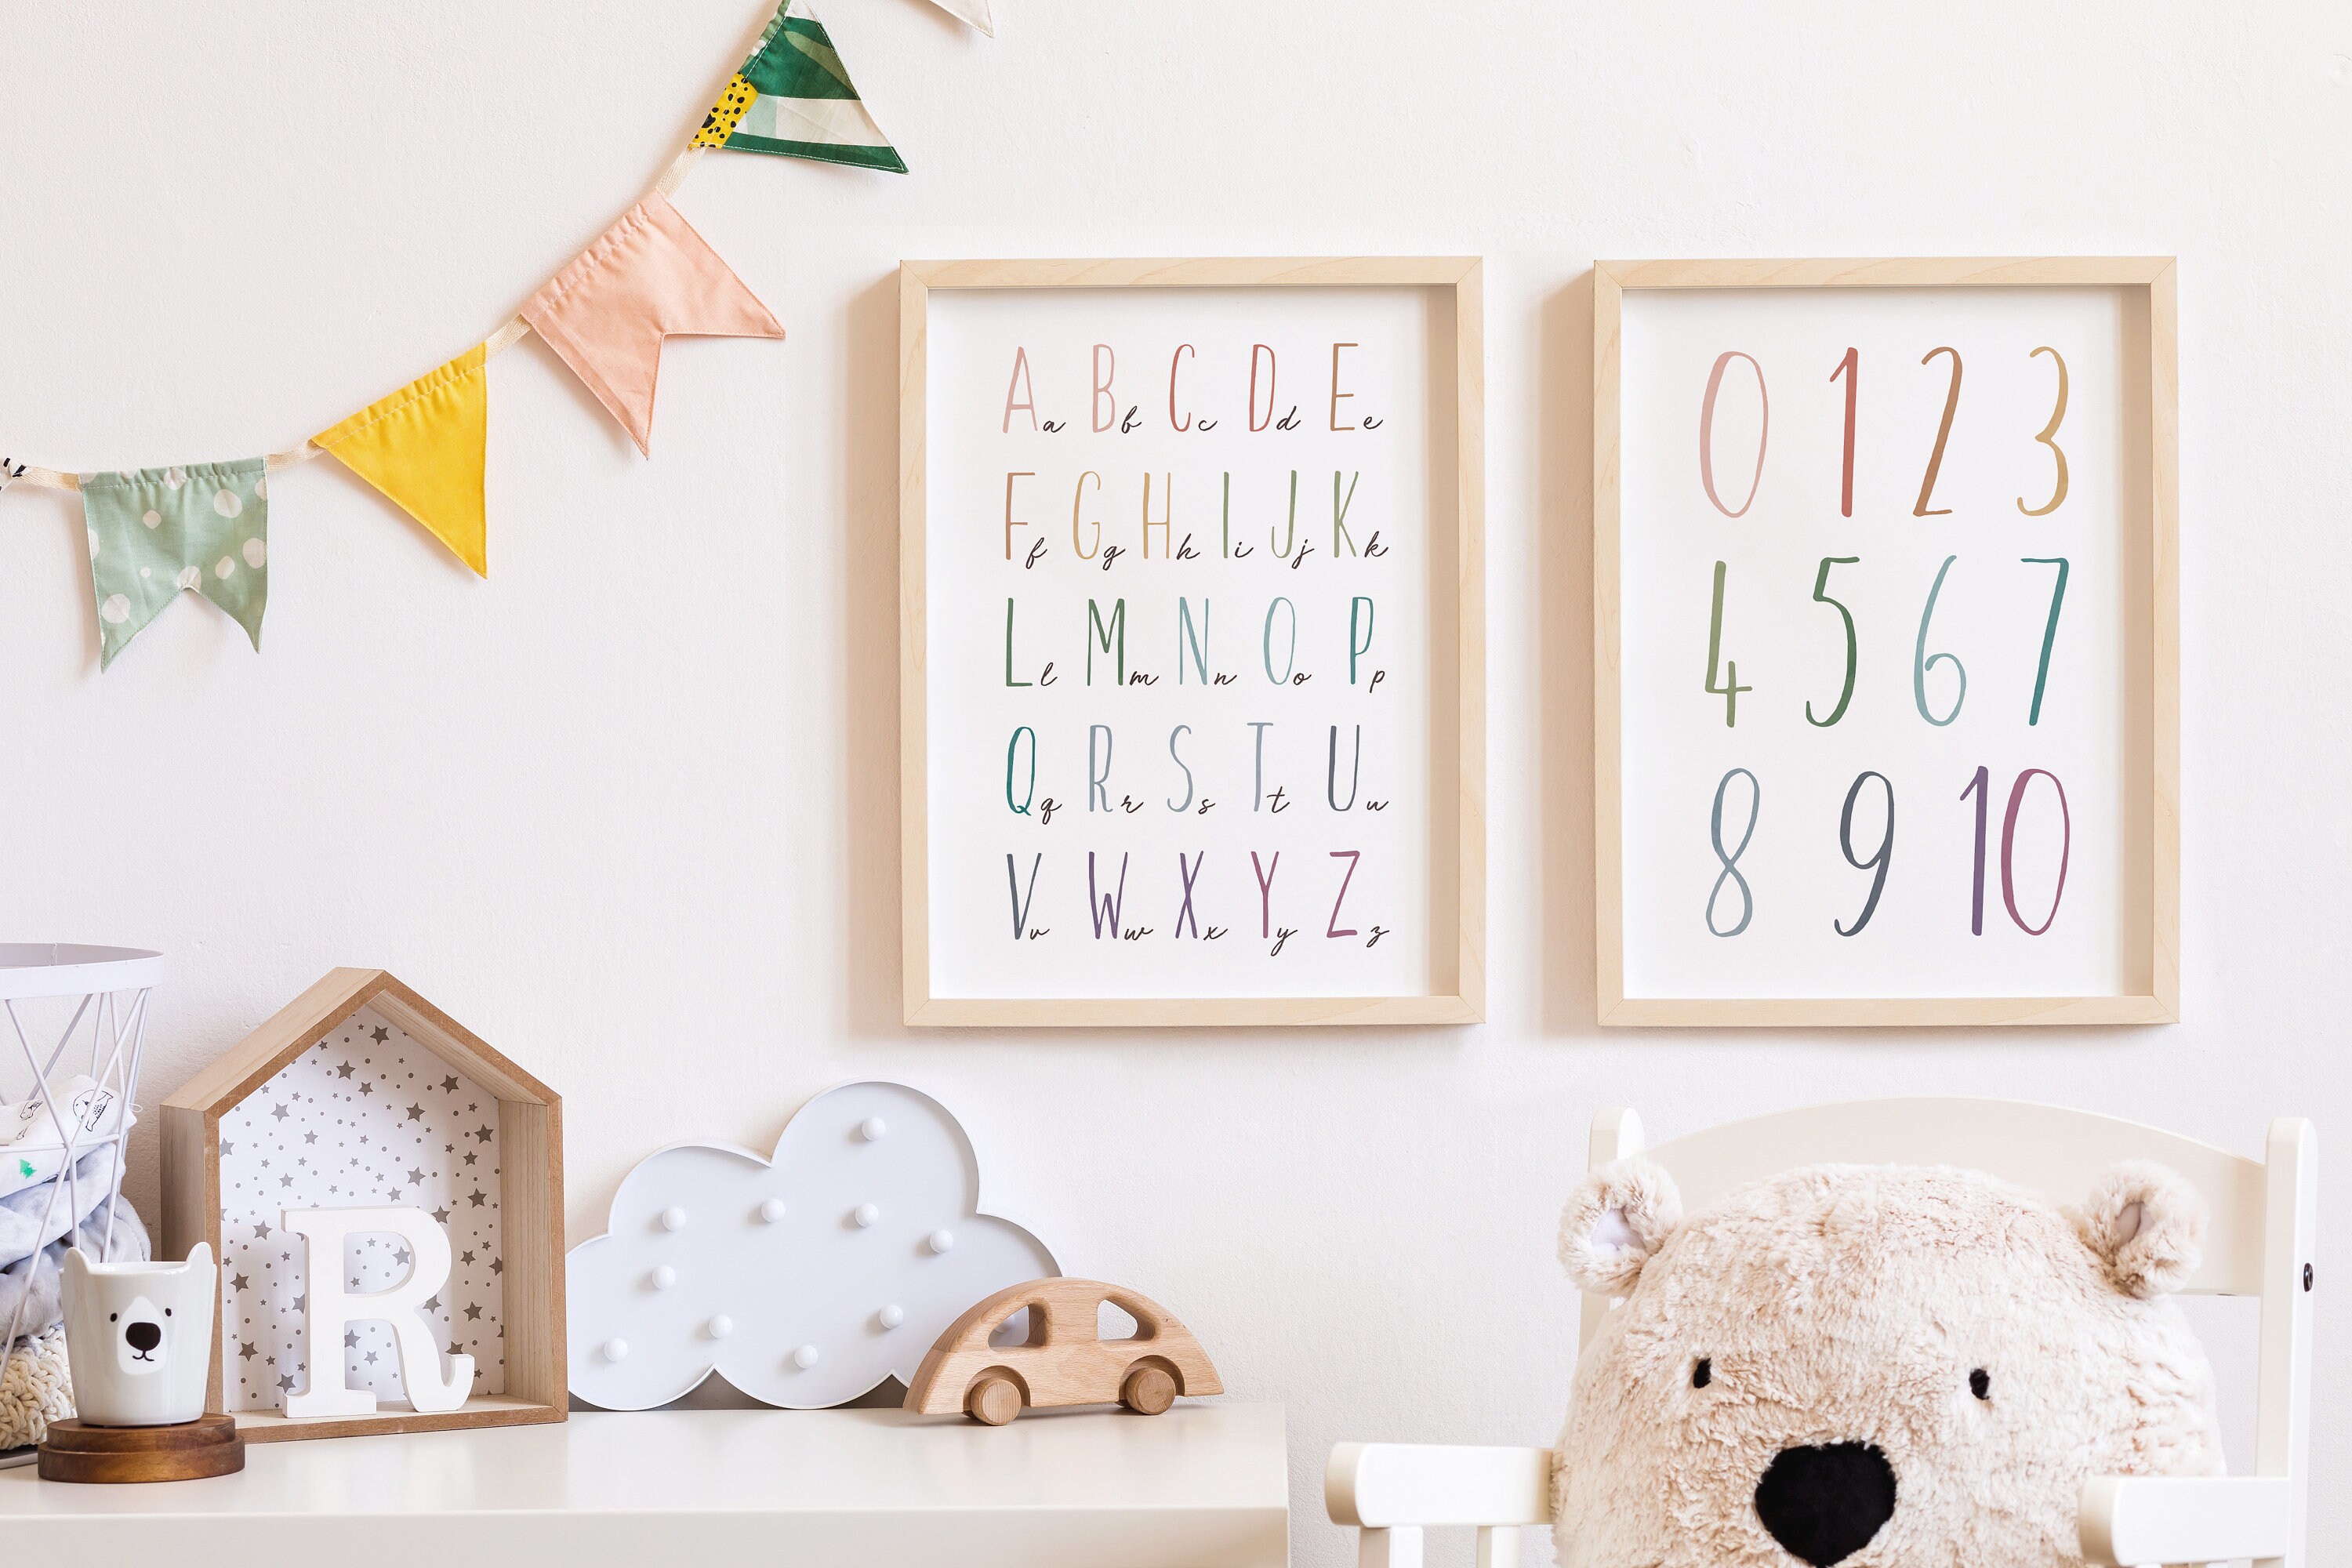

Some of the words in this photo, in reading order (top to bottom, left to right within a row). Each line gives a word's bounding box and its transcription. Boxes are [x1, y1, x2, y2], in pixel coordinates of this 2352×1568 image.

[1699, 350, 1769, 519] 0
[1829, 347, 1859, 518] 1
[1912, 346, 1963, 518] 2
[2016, 346, 2069, 517] 3
[1704, 560, 1753, 728] 4
[1805, 556, 1860, 728] 5
[1913, 554, 1967, 728] 6
[2020, 557, 2070, 727] 7
[1705, 768, 1761, 938] 8
[1834, 771, 1895, 938] 9
[1959, 765, 2071, 937] 10
[281, 1206, 474, 1417] R
